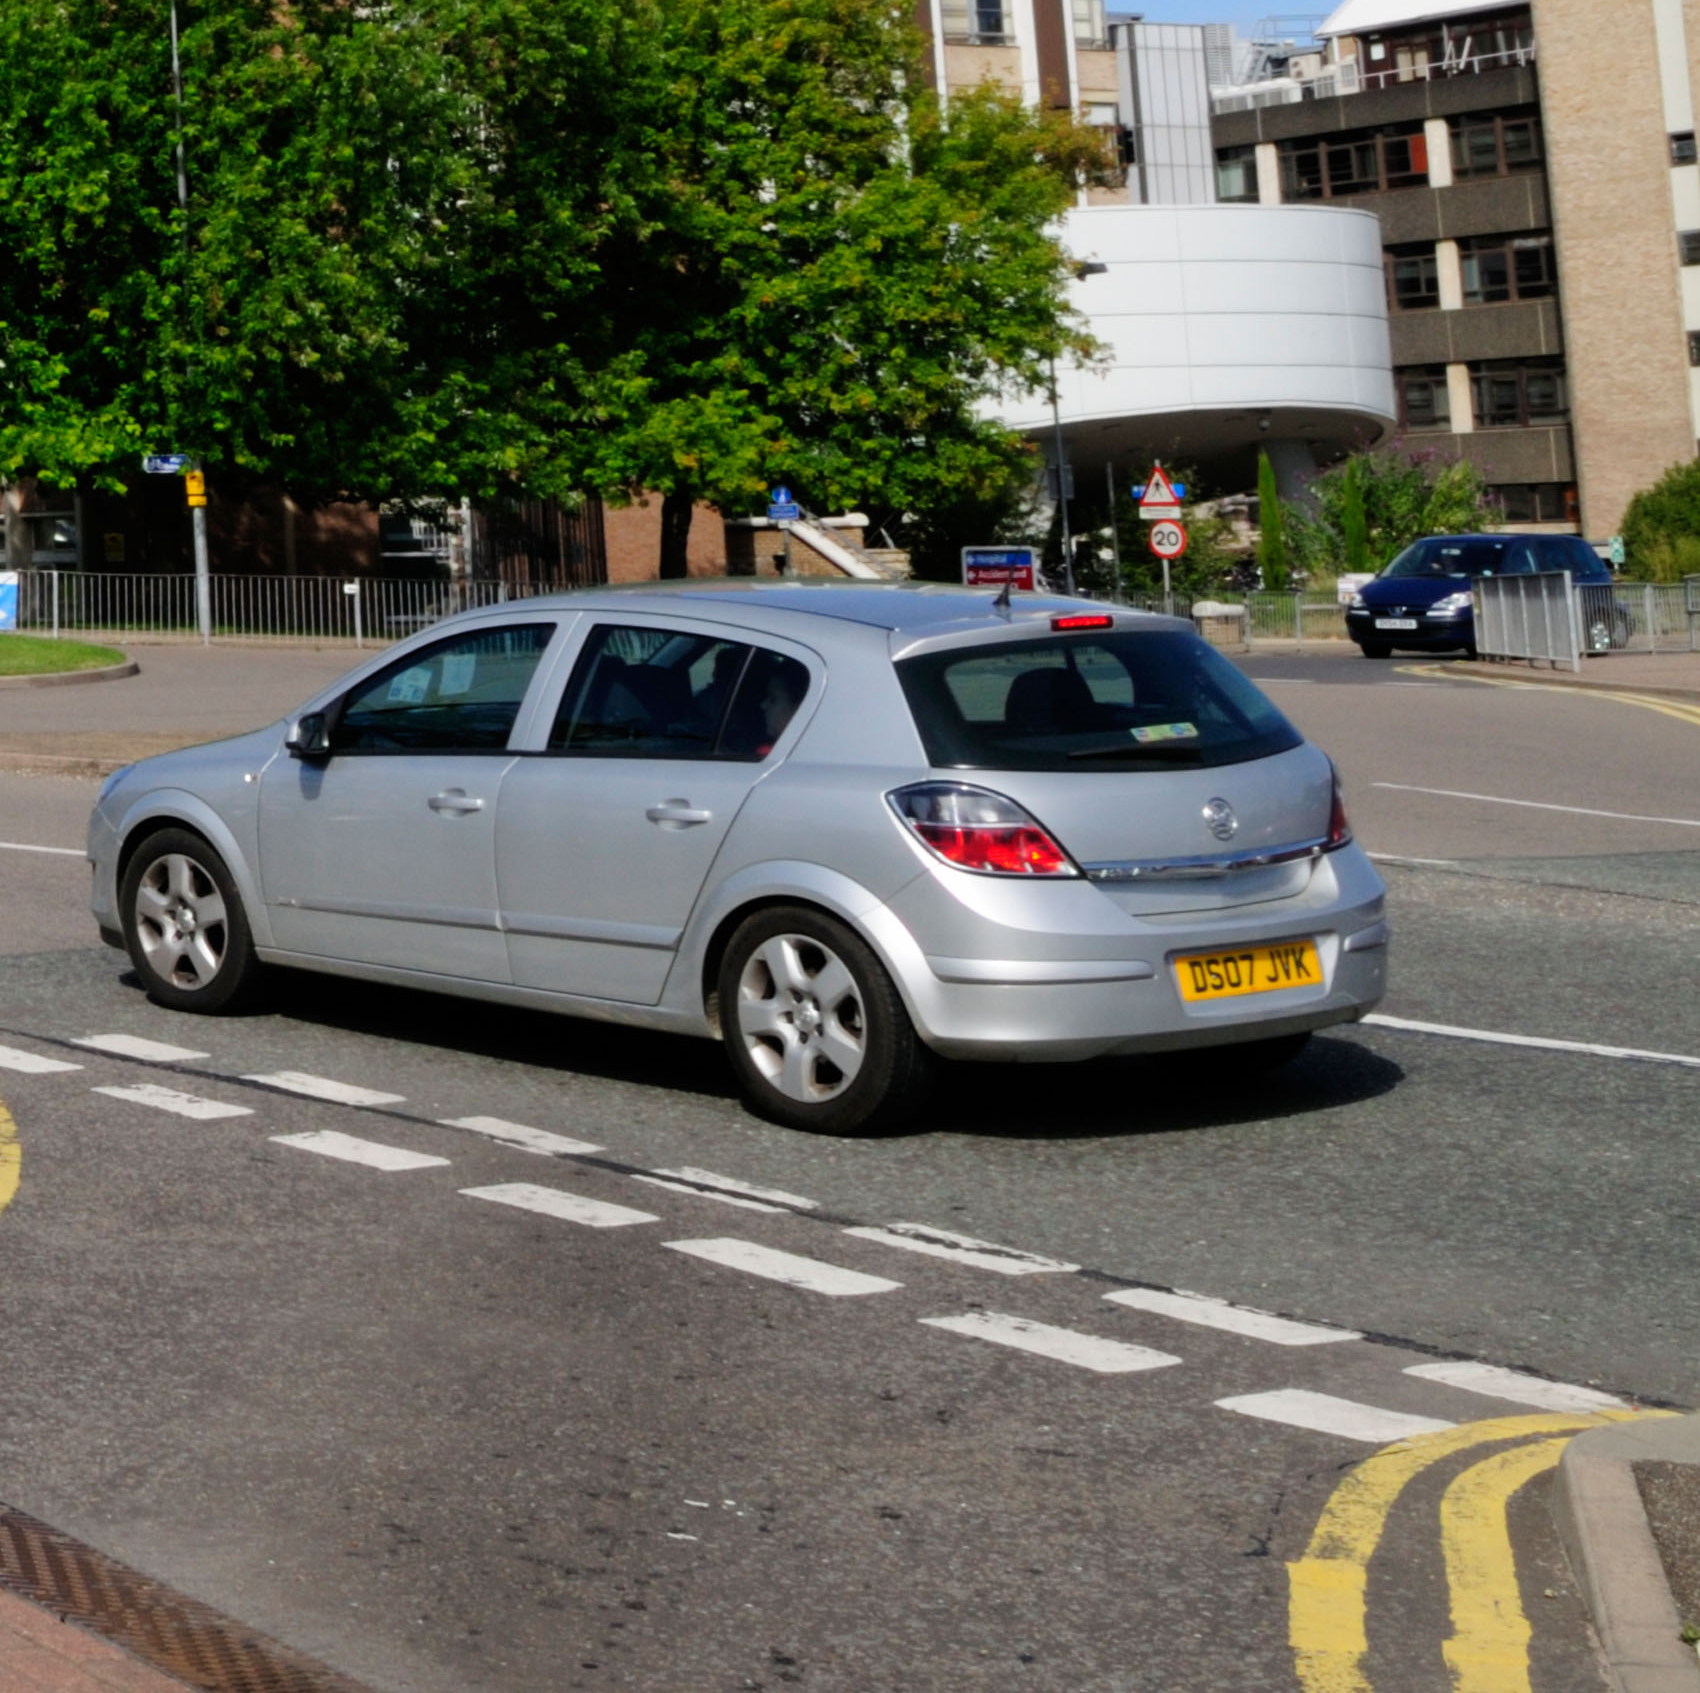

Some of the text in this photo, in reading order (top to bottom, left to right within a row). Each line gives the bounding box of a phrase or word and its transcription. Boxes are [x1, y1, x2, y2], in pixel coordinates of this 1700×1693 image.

[1154, 530, 1180, 547] 20
[1188, 946, 1312, 994] DS07 JVK
